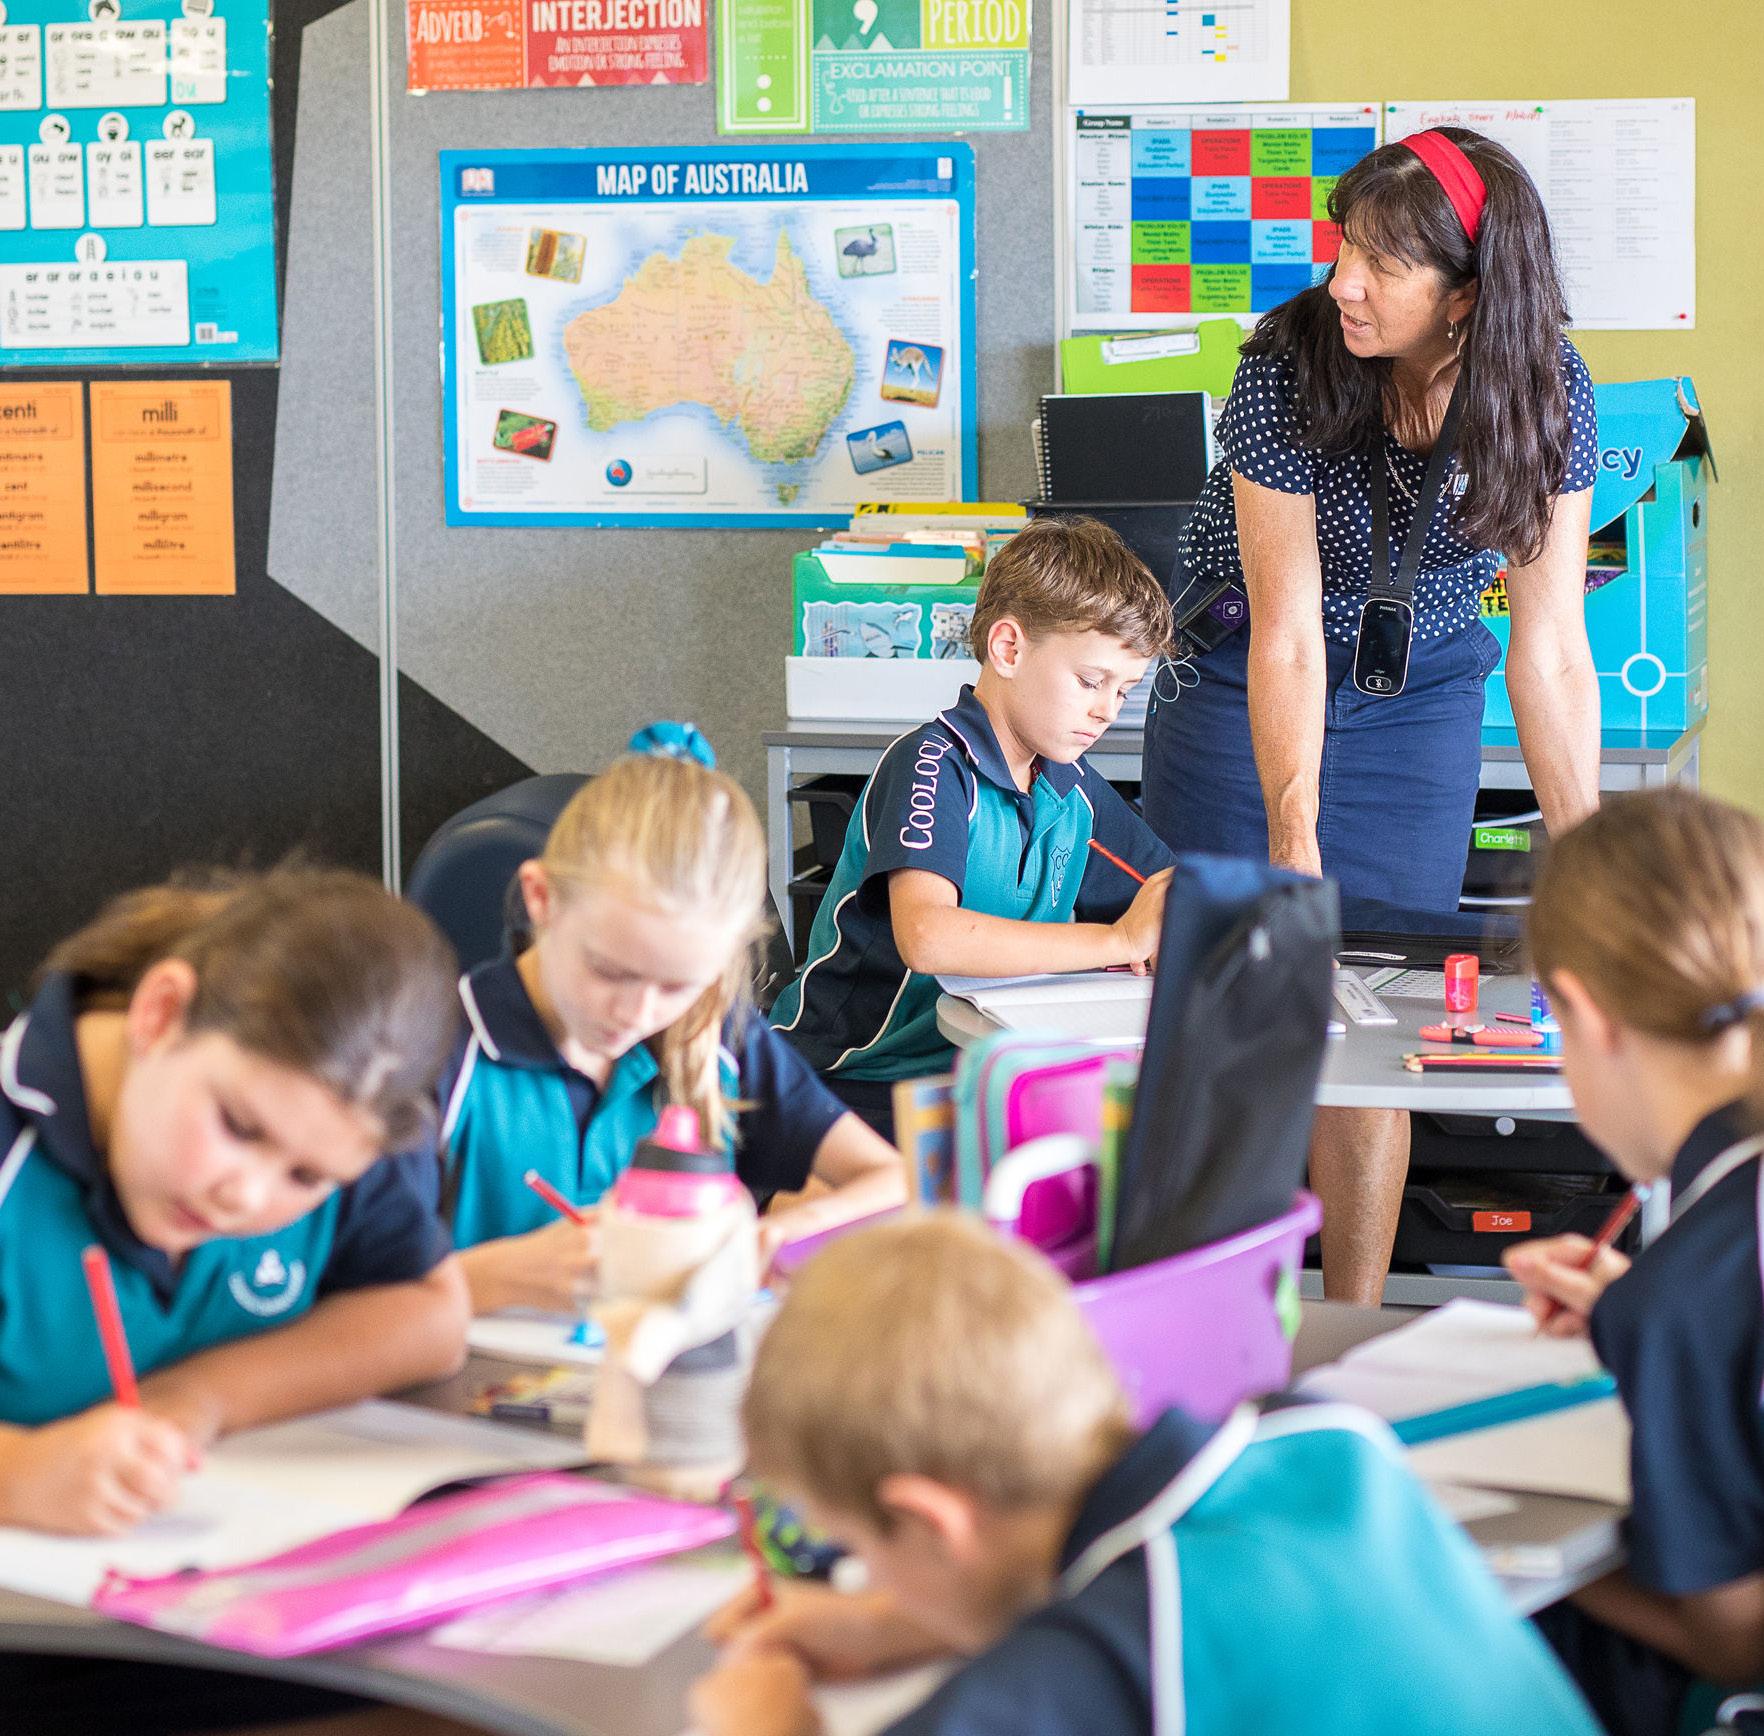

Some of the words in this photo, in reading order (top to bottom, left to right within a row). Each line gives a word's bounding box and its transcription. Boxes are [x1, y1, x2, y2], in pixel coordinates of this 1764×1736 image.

[416, 8, 483, 43] ADVERB
[532, 0, 702, 32] INTERJECTION
[928, 0, 1021, 43] PERIOD
[829, 61, 959, 79] EXCLAMATION
[960, 59, 1013, 77] POINT
[596, 164, 645, 195] MAP
[651, 163, 680, 194] OF
[684, 161, 809, 194] AUSTRALIA
[0, 400, 37, 419] enti
[142, 400, 178, 423] milli
[1601, 448, 1643, 479] cy
[1490, 1215, 1513, 1227] Joe
